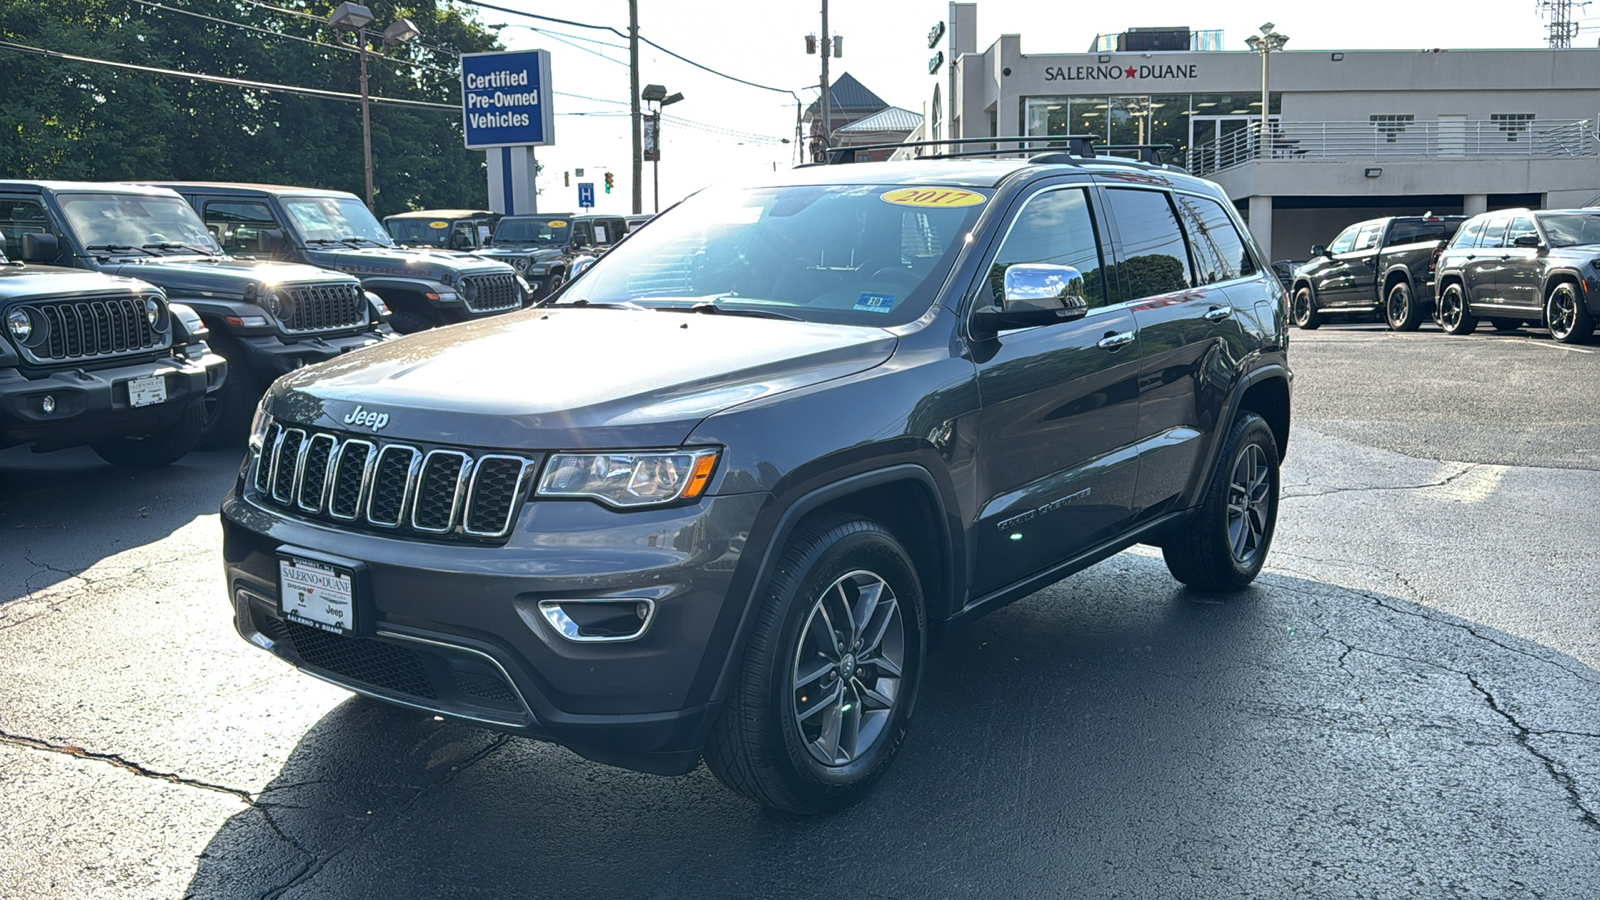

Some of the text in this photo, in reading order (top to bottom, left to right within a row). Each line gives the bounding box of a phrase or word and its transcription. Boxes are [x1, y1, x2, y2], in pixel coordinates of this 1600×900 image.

[466, 69, 528, 89] Certified
[1045, 65, 1198, 81] SALERNO DUANE
[468, 89, 538, 109] Pre-Owned
[469, 112, 530, 129] Vehicles
[581, 188, 591, 201] H
[895, 191, 973, 204] 2017
[341, 264, 432, 277] RUBICON
[870, 298, 881, 306] 10
[344, 405, 389, 432] Jeep
[283, 567, 351, 593] SALERNO DUANE
[326, 605, 344, 618] Jeep
[287, 614, 343, 635] SALERNO DUANE
